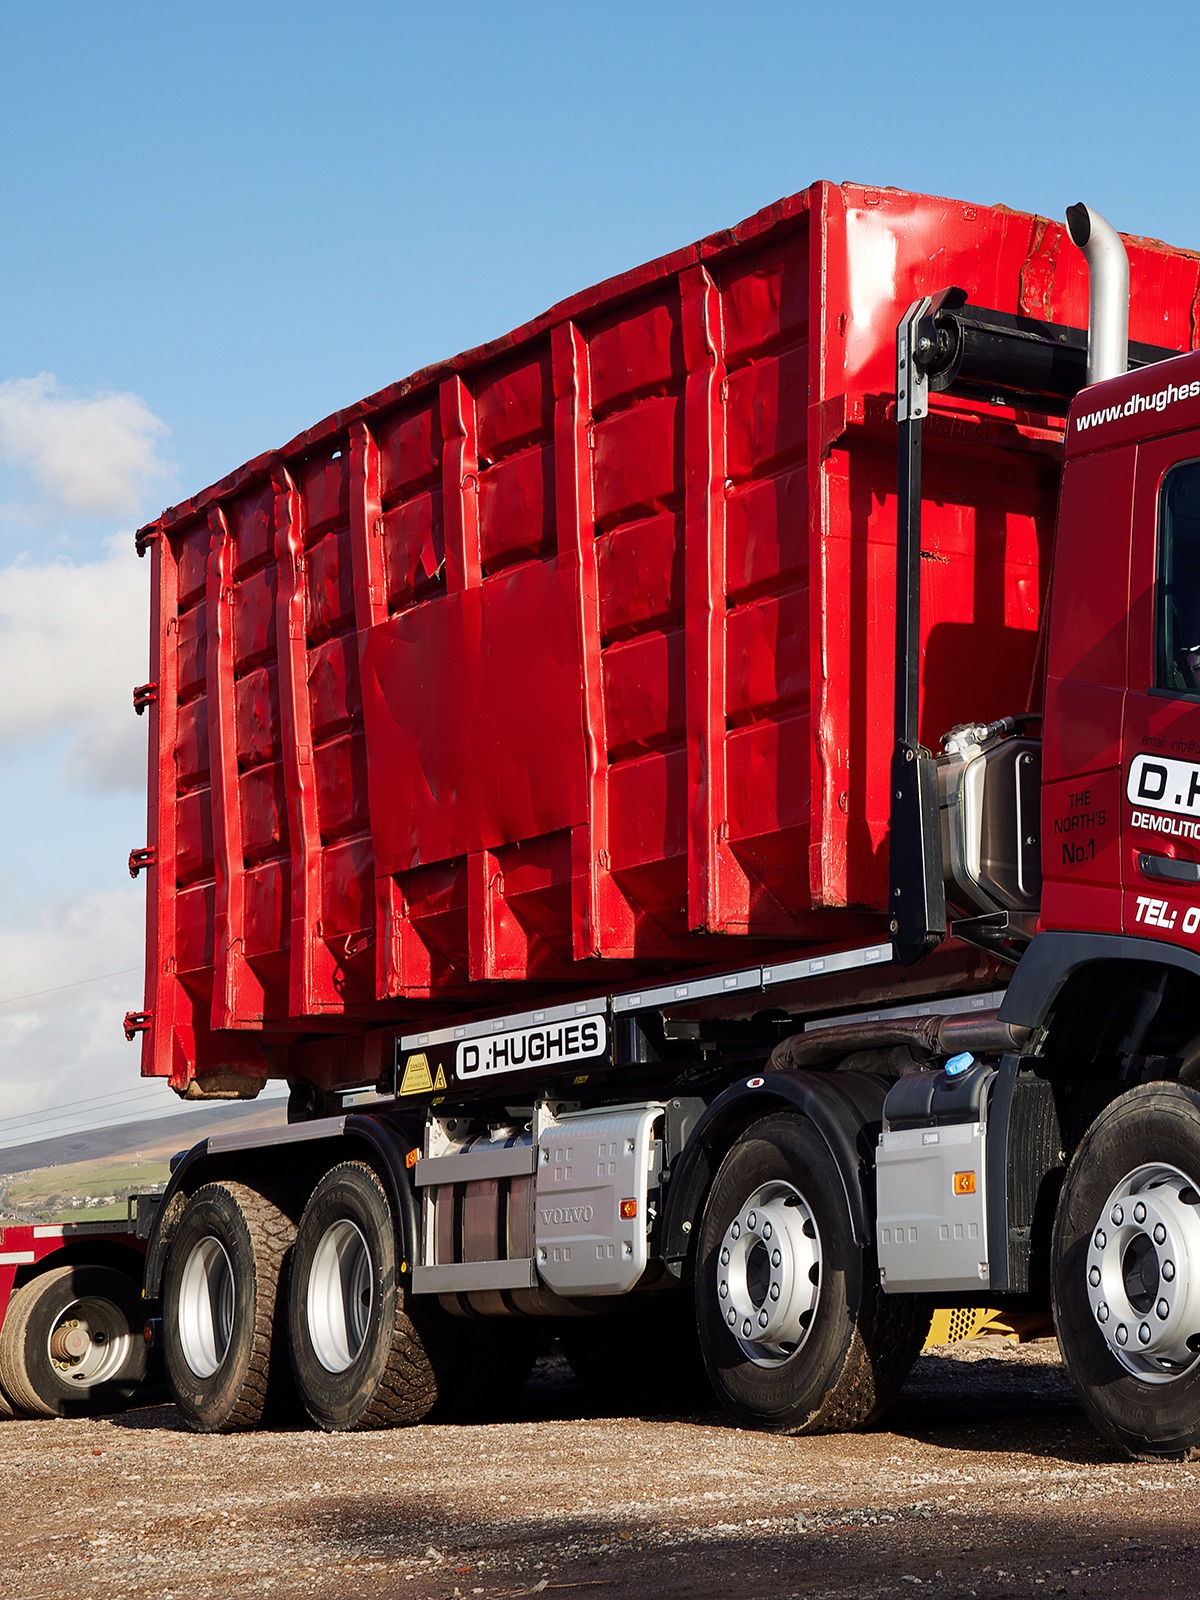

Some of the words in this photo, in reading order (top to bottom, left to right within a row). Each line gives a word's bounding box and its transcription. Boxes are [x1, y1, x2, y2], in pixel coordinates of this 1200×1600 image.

[1141, 736, 1167, 749] email:
[1068, 790, 1091, 808] THE
[1053, 810, 1107, 835] NORTH'S
[1061, 840, 1097, 866] No.1
[1134, 896, 1176, 929] TEL:
[540, 1205, 594, 1225] VOLVO
